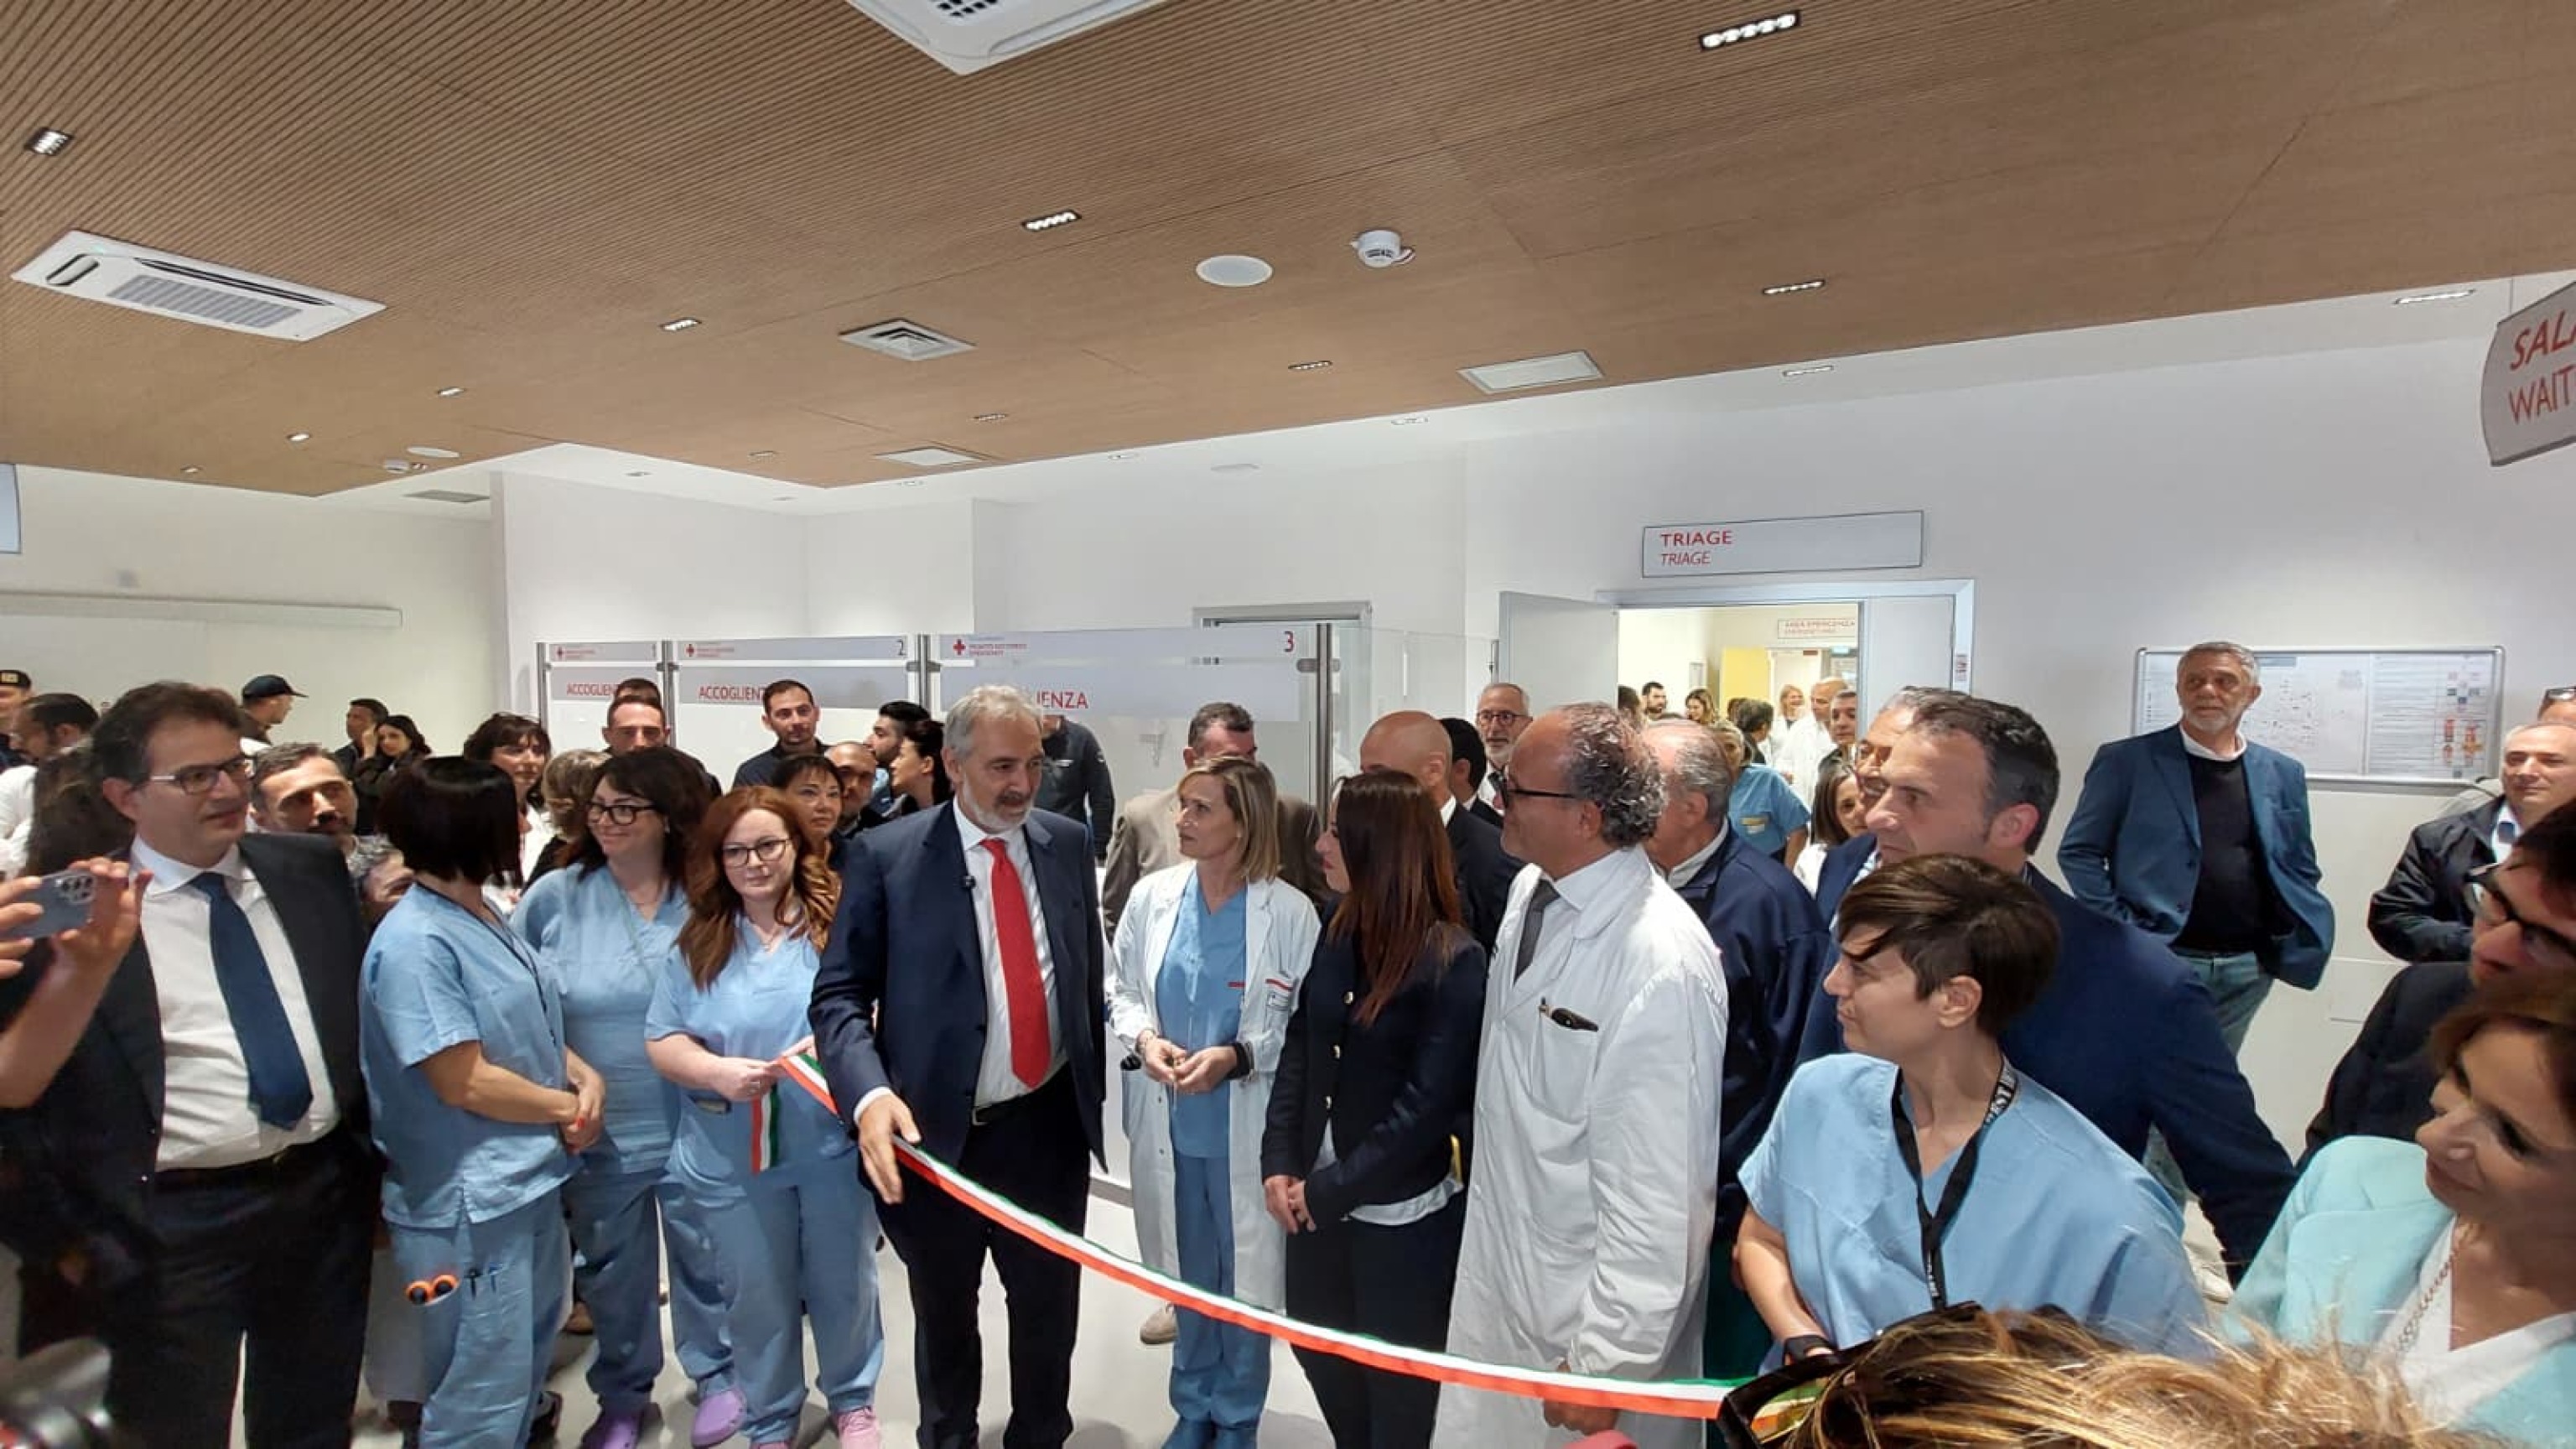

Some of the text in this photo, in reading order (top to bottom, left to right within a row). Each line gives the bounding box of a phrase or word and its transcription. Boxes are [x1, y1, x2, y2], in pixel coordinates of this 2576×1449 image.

[2509, 309, 2576, 371] SAL
[2508, 363, 2576, 425] WAIT
[1659, 529, 1733, 548] TRIAGE
[1659, 550, 1711, 567] TRIAGE
[896, 638, 907, 656] 2
[1284, 630, 1295, 652] 3
[566, 683, 619, 696] ACCOGLIEN
